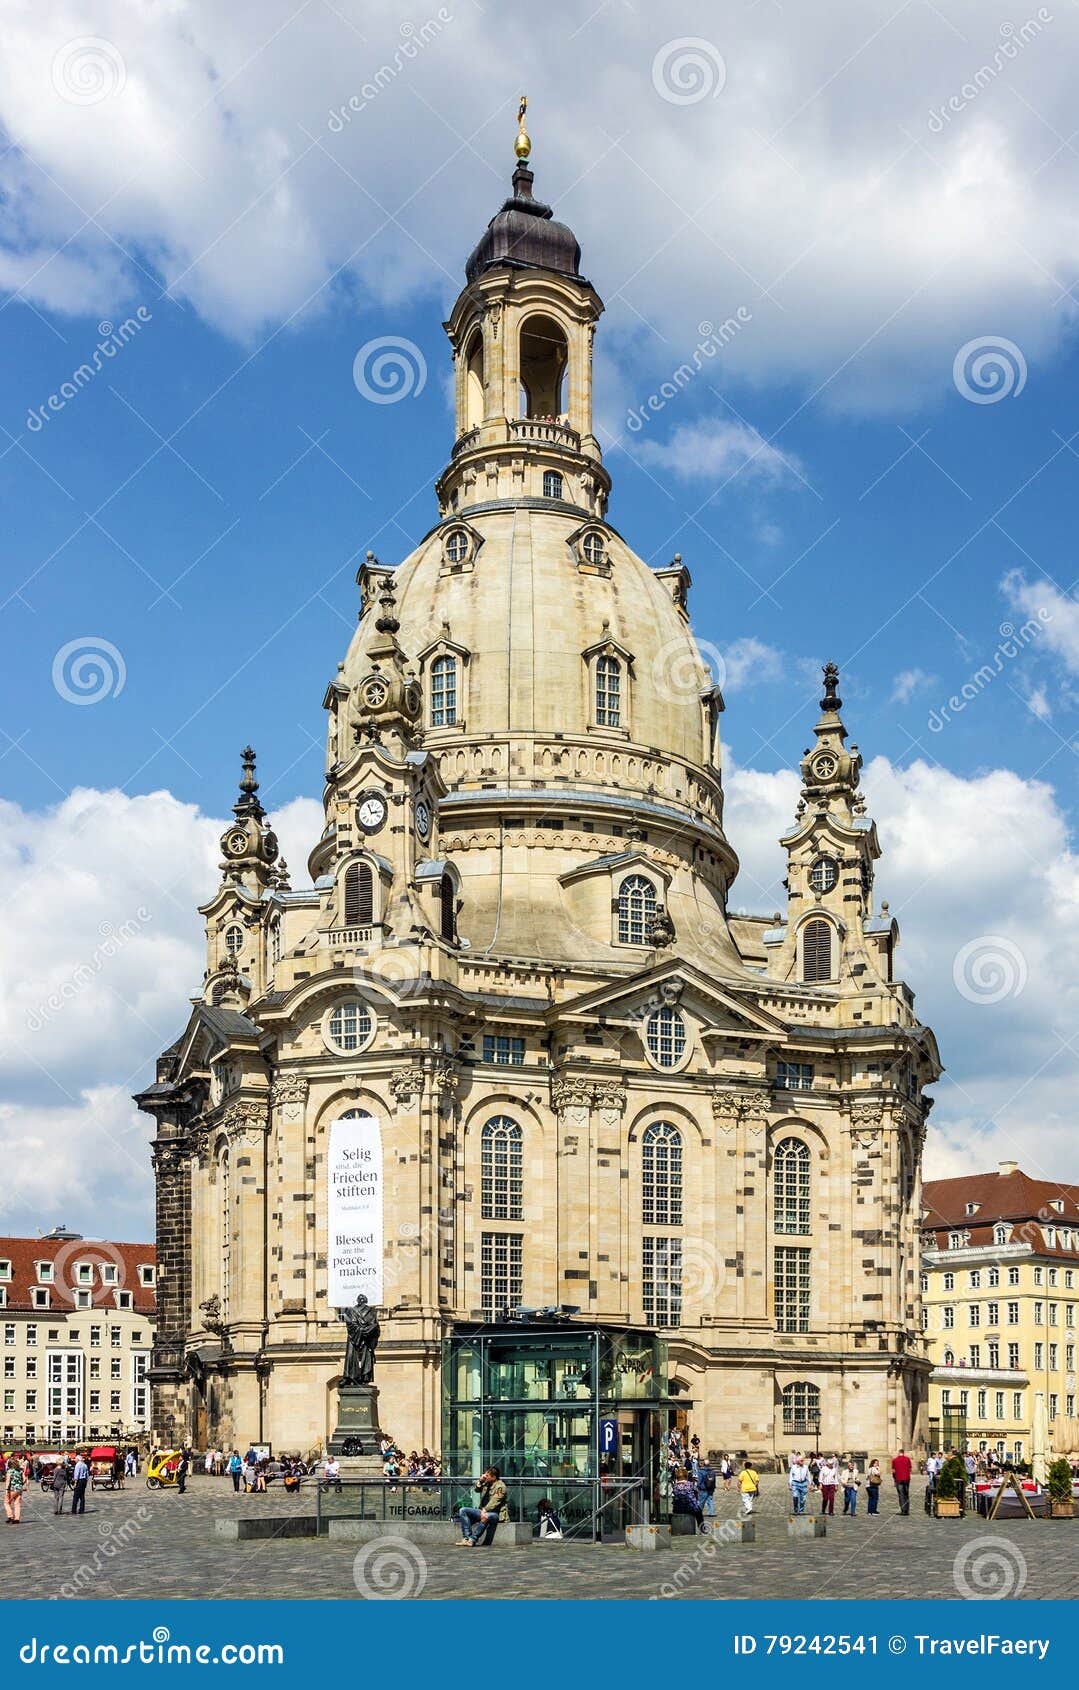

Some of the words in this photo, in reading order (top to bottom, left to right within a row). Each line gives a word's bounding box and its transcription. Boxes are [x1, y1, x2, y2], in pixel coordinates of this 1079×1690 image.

[343, 1147, 371, 1162] Selig
[333, 1170, 378, 1184] Frieden
[336, 1184, 375, 1197] stiften
[336, 1234, 373, 1245] Blessed
[333, 1257, 366, 1268] peace-
[340, 1265, 377, 1277] makers
[605, 1427, 613, 1451] P
[389, 1505, 447, 1517] TIEFGARAGE
